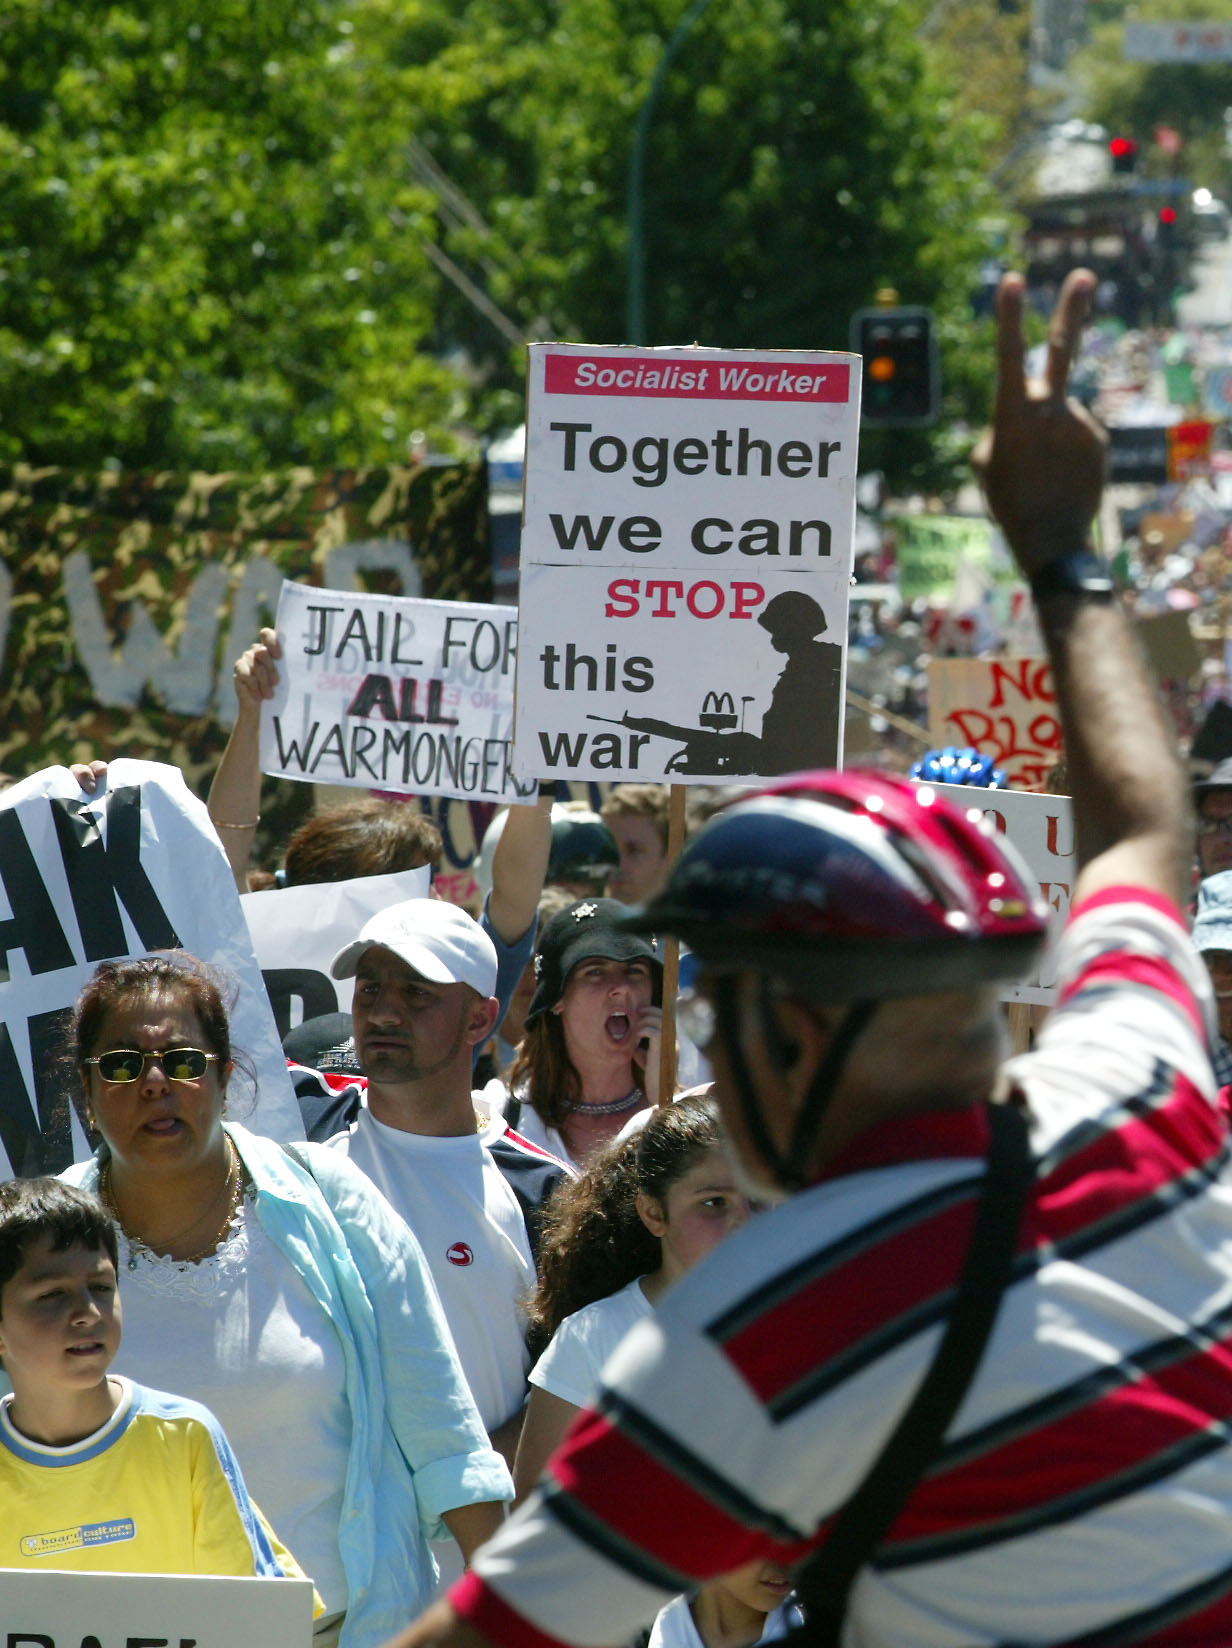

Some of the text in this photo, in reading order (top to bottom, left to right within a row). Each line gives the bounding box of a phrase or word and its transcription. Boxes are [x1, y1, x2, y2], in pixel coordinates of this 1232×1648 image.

[574, 361, 827, 394] Socialist Worker
[549, 421, 842, 488] Together
[548, 513, 832, 557] we can
[604, 578, 766, 620] STOP
[303, 605, 424, 666] JAIL
[539, 643, 655, 693] this
[346, 673, 460, 727] ALL
[537, 730, 651, 770] war
